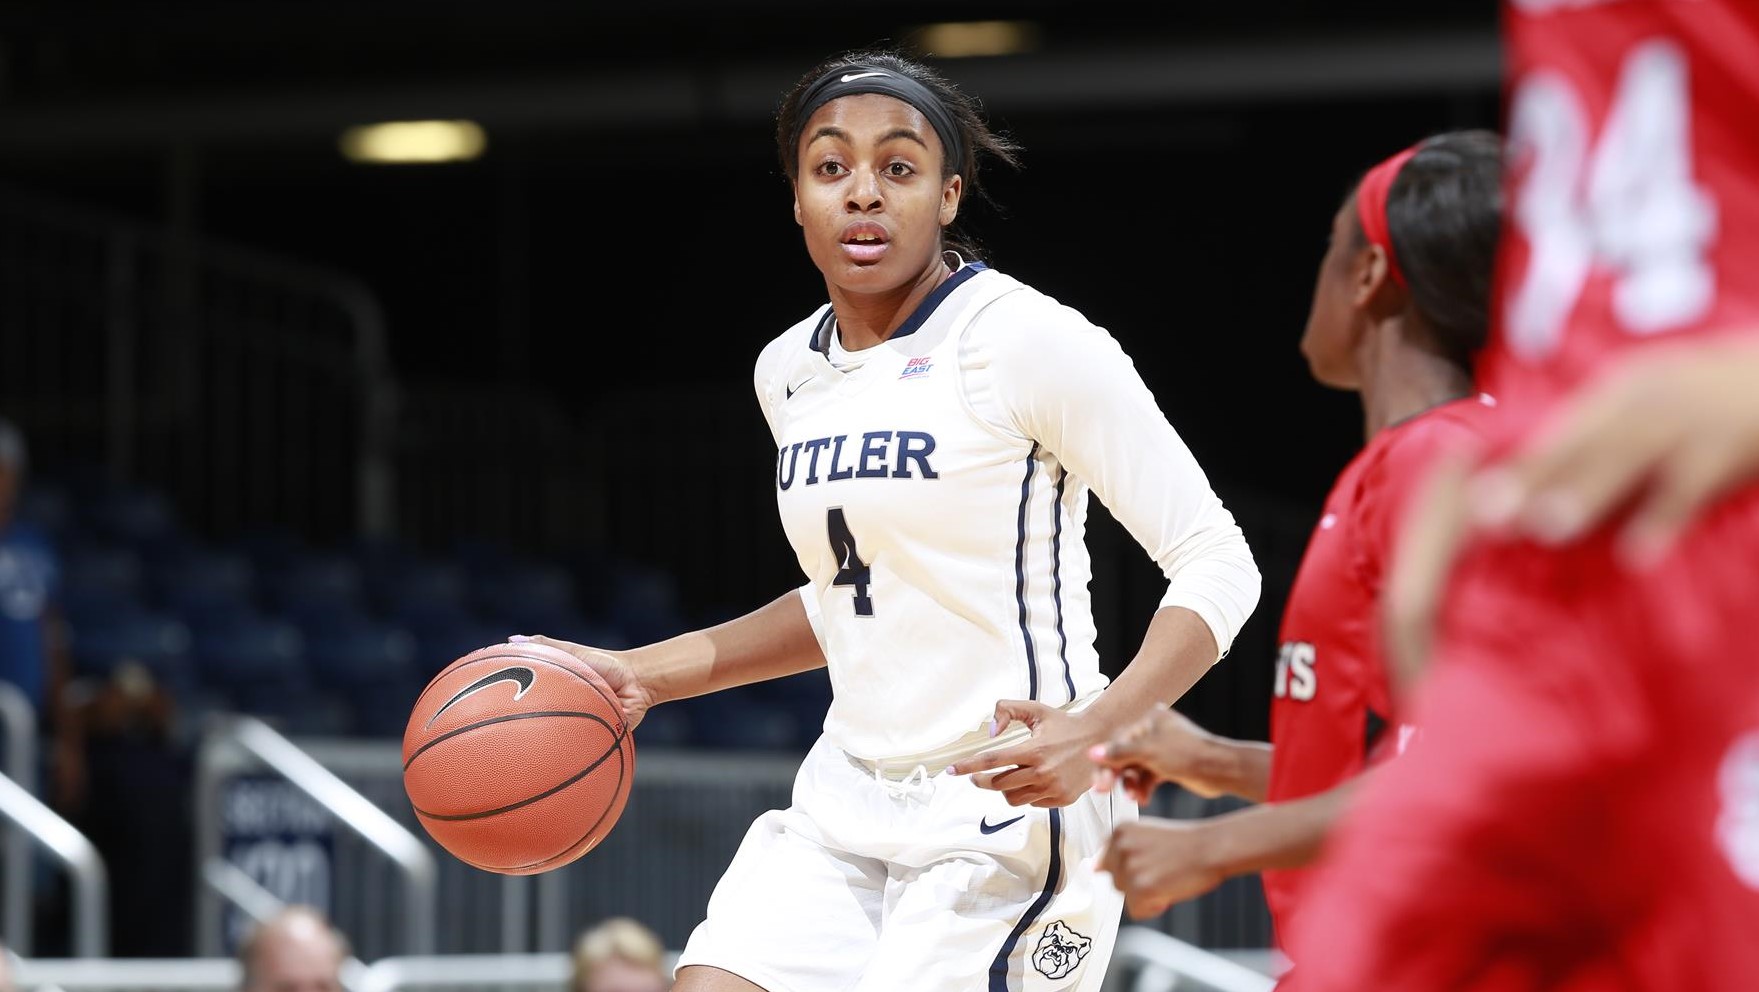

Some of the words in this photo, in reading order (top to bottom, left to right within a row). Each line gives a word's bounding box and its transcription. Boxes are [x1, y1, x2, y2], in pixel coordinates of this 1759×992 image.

[907, 357, 931, 367] BIG
[901, 364, 934, 375] EAST
[826, 505, 875, 618] 4
